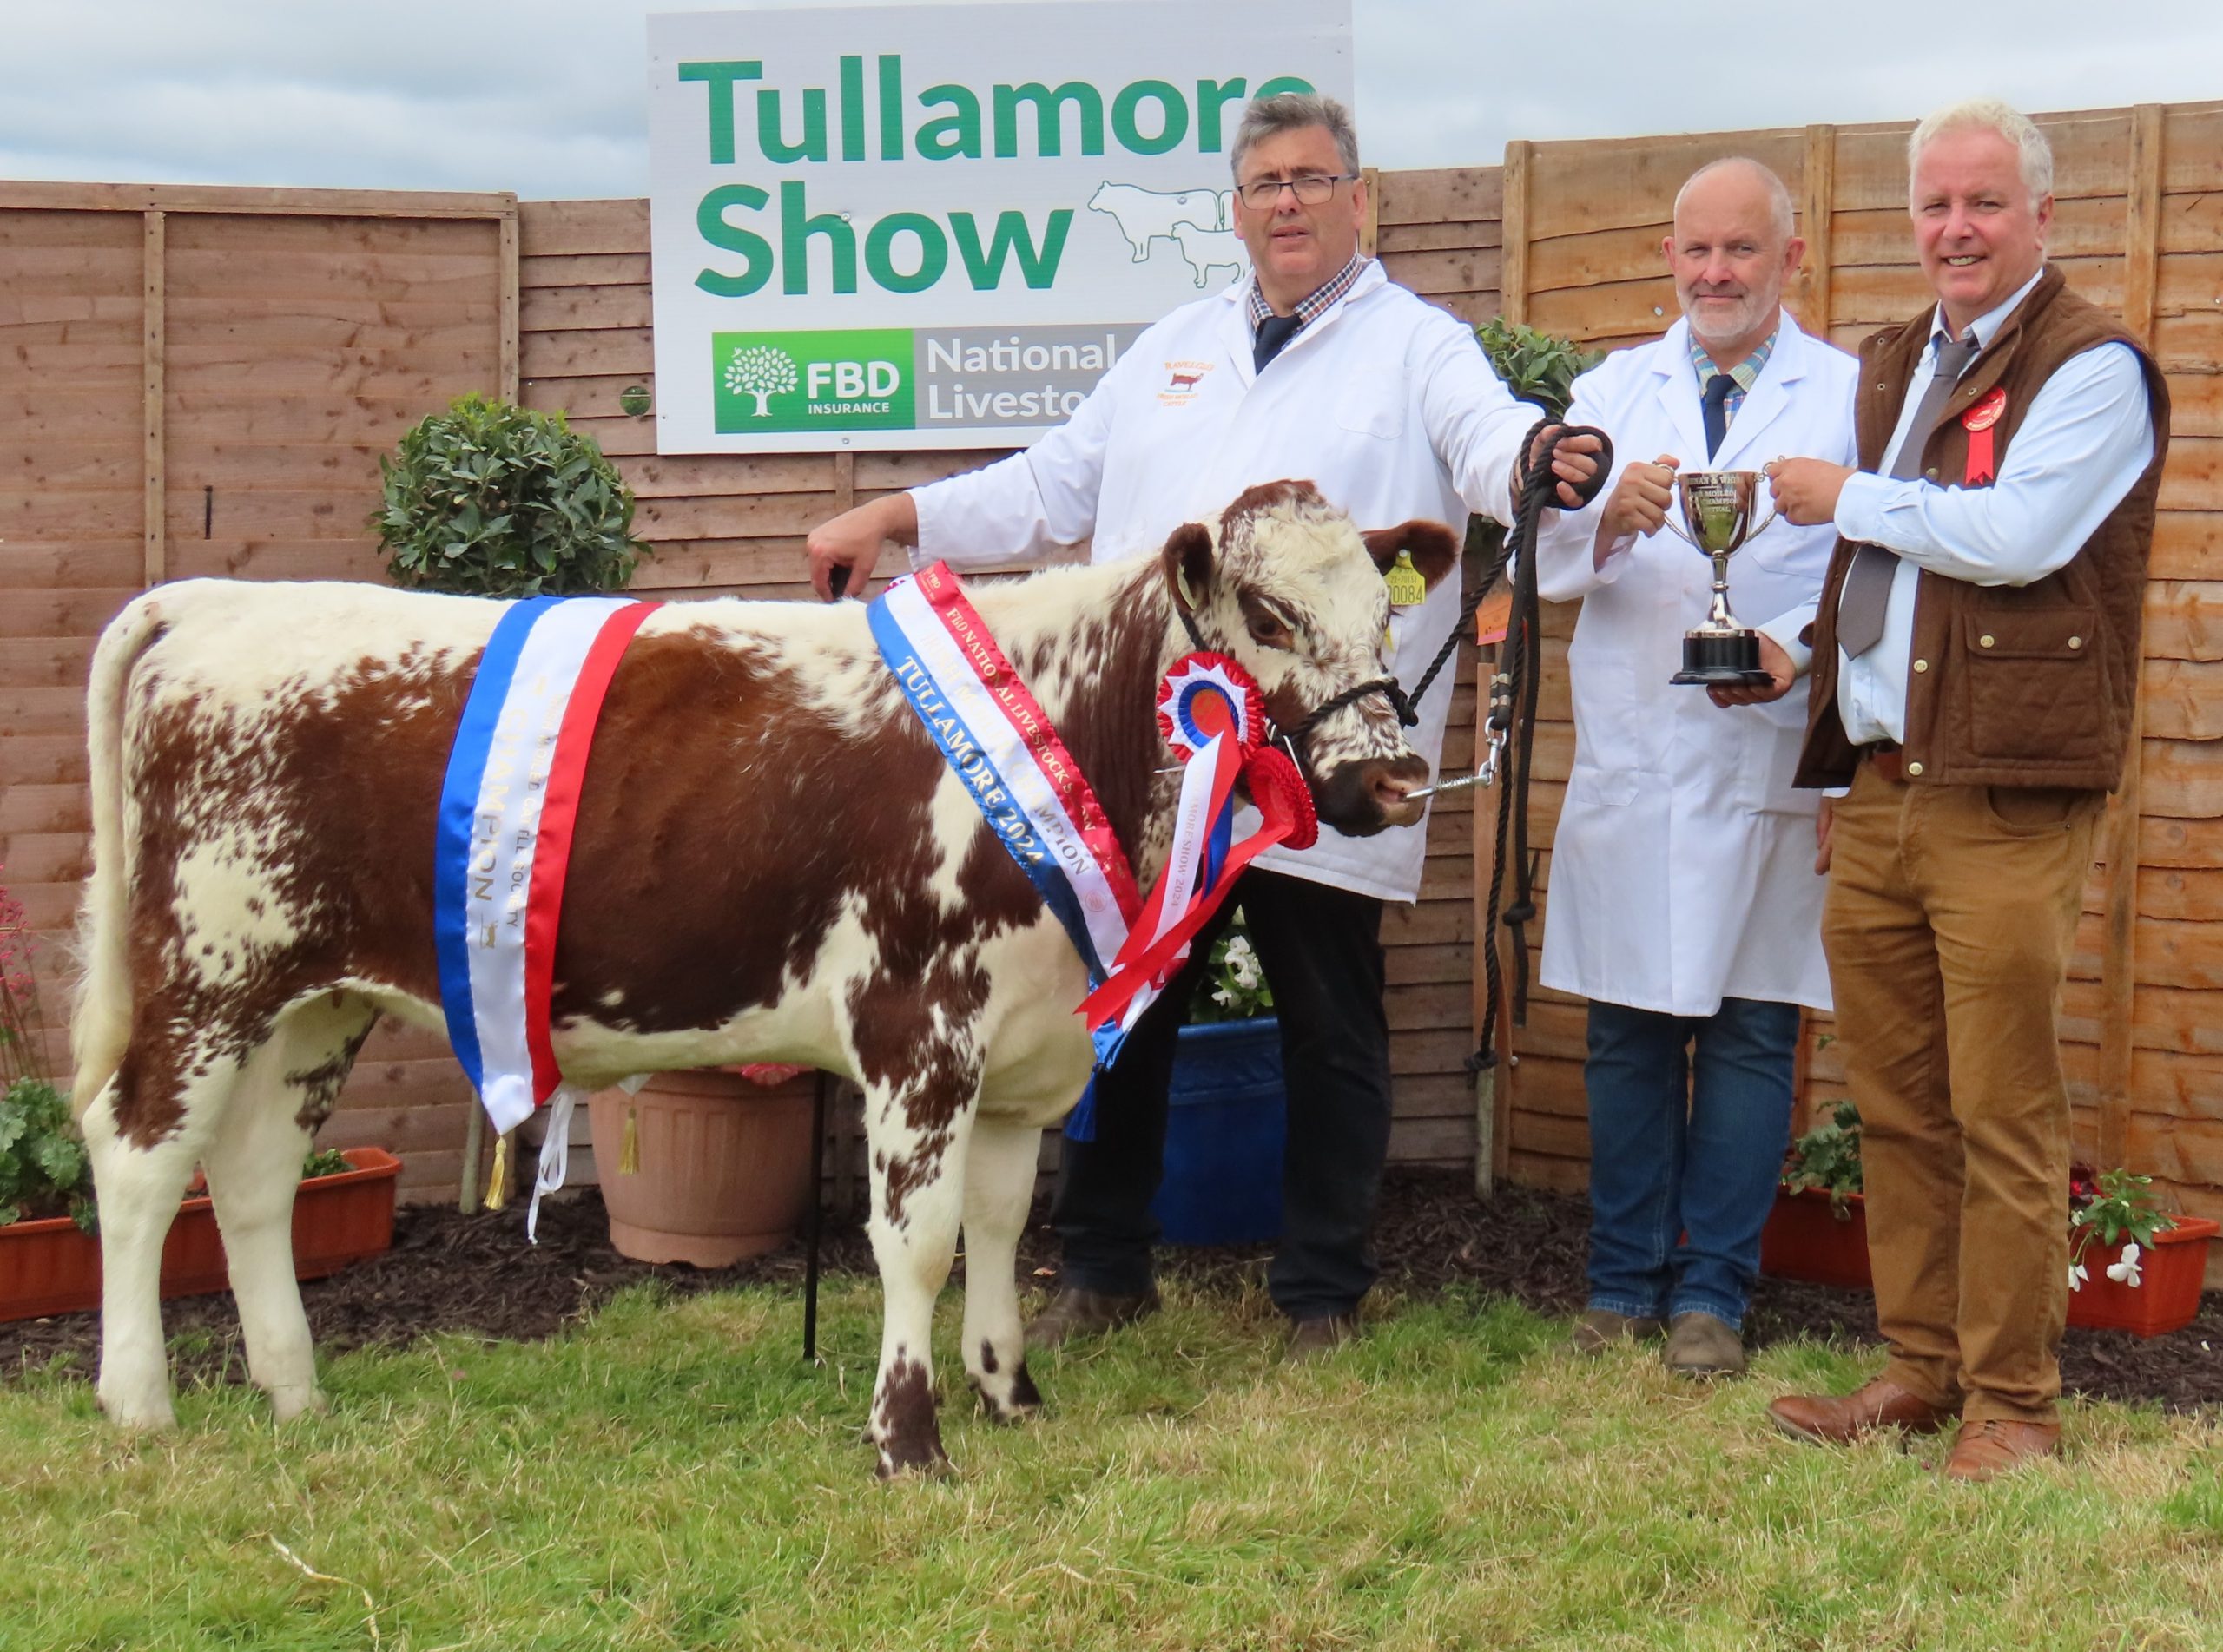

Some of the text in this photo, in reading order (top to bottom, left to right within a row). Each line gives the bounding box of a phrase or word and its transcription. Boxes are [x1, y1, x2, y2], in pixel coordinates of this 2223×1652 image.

[678, 54, 1316, 165] Tullamor
[695, 181, 1074, 298] Show
[808, 361, 900, 399] FBD
[927, 333, 1115, 372] National
[808, 402, 890, 415] INSURANCE
[945, 607, 969, 634] FBD
[960, 629, 1017, 708] NATIOAL
[894, 655, 1007, 810] TULLAMORE
[474, 708, 530, 901] CHAMPION
[515, 797, 535, 853] CATTLE
[1178, 840, 1191, 875] SHOW
[506, 859, 524, 927] SOCIETY
[1171, 879, 1184, 906] 2024
